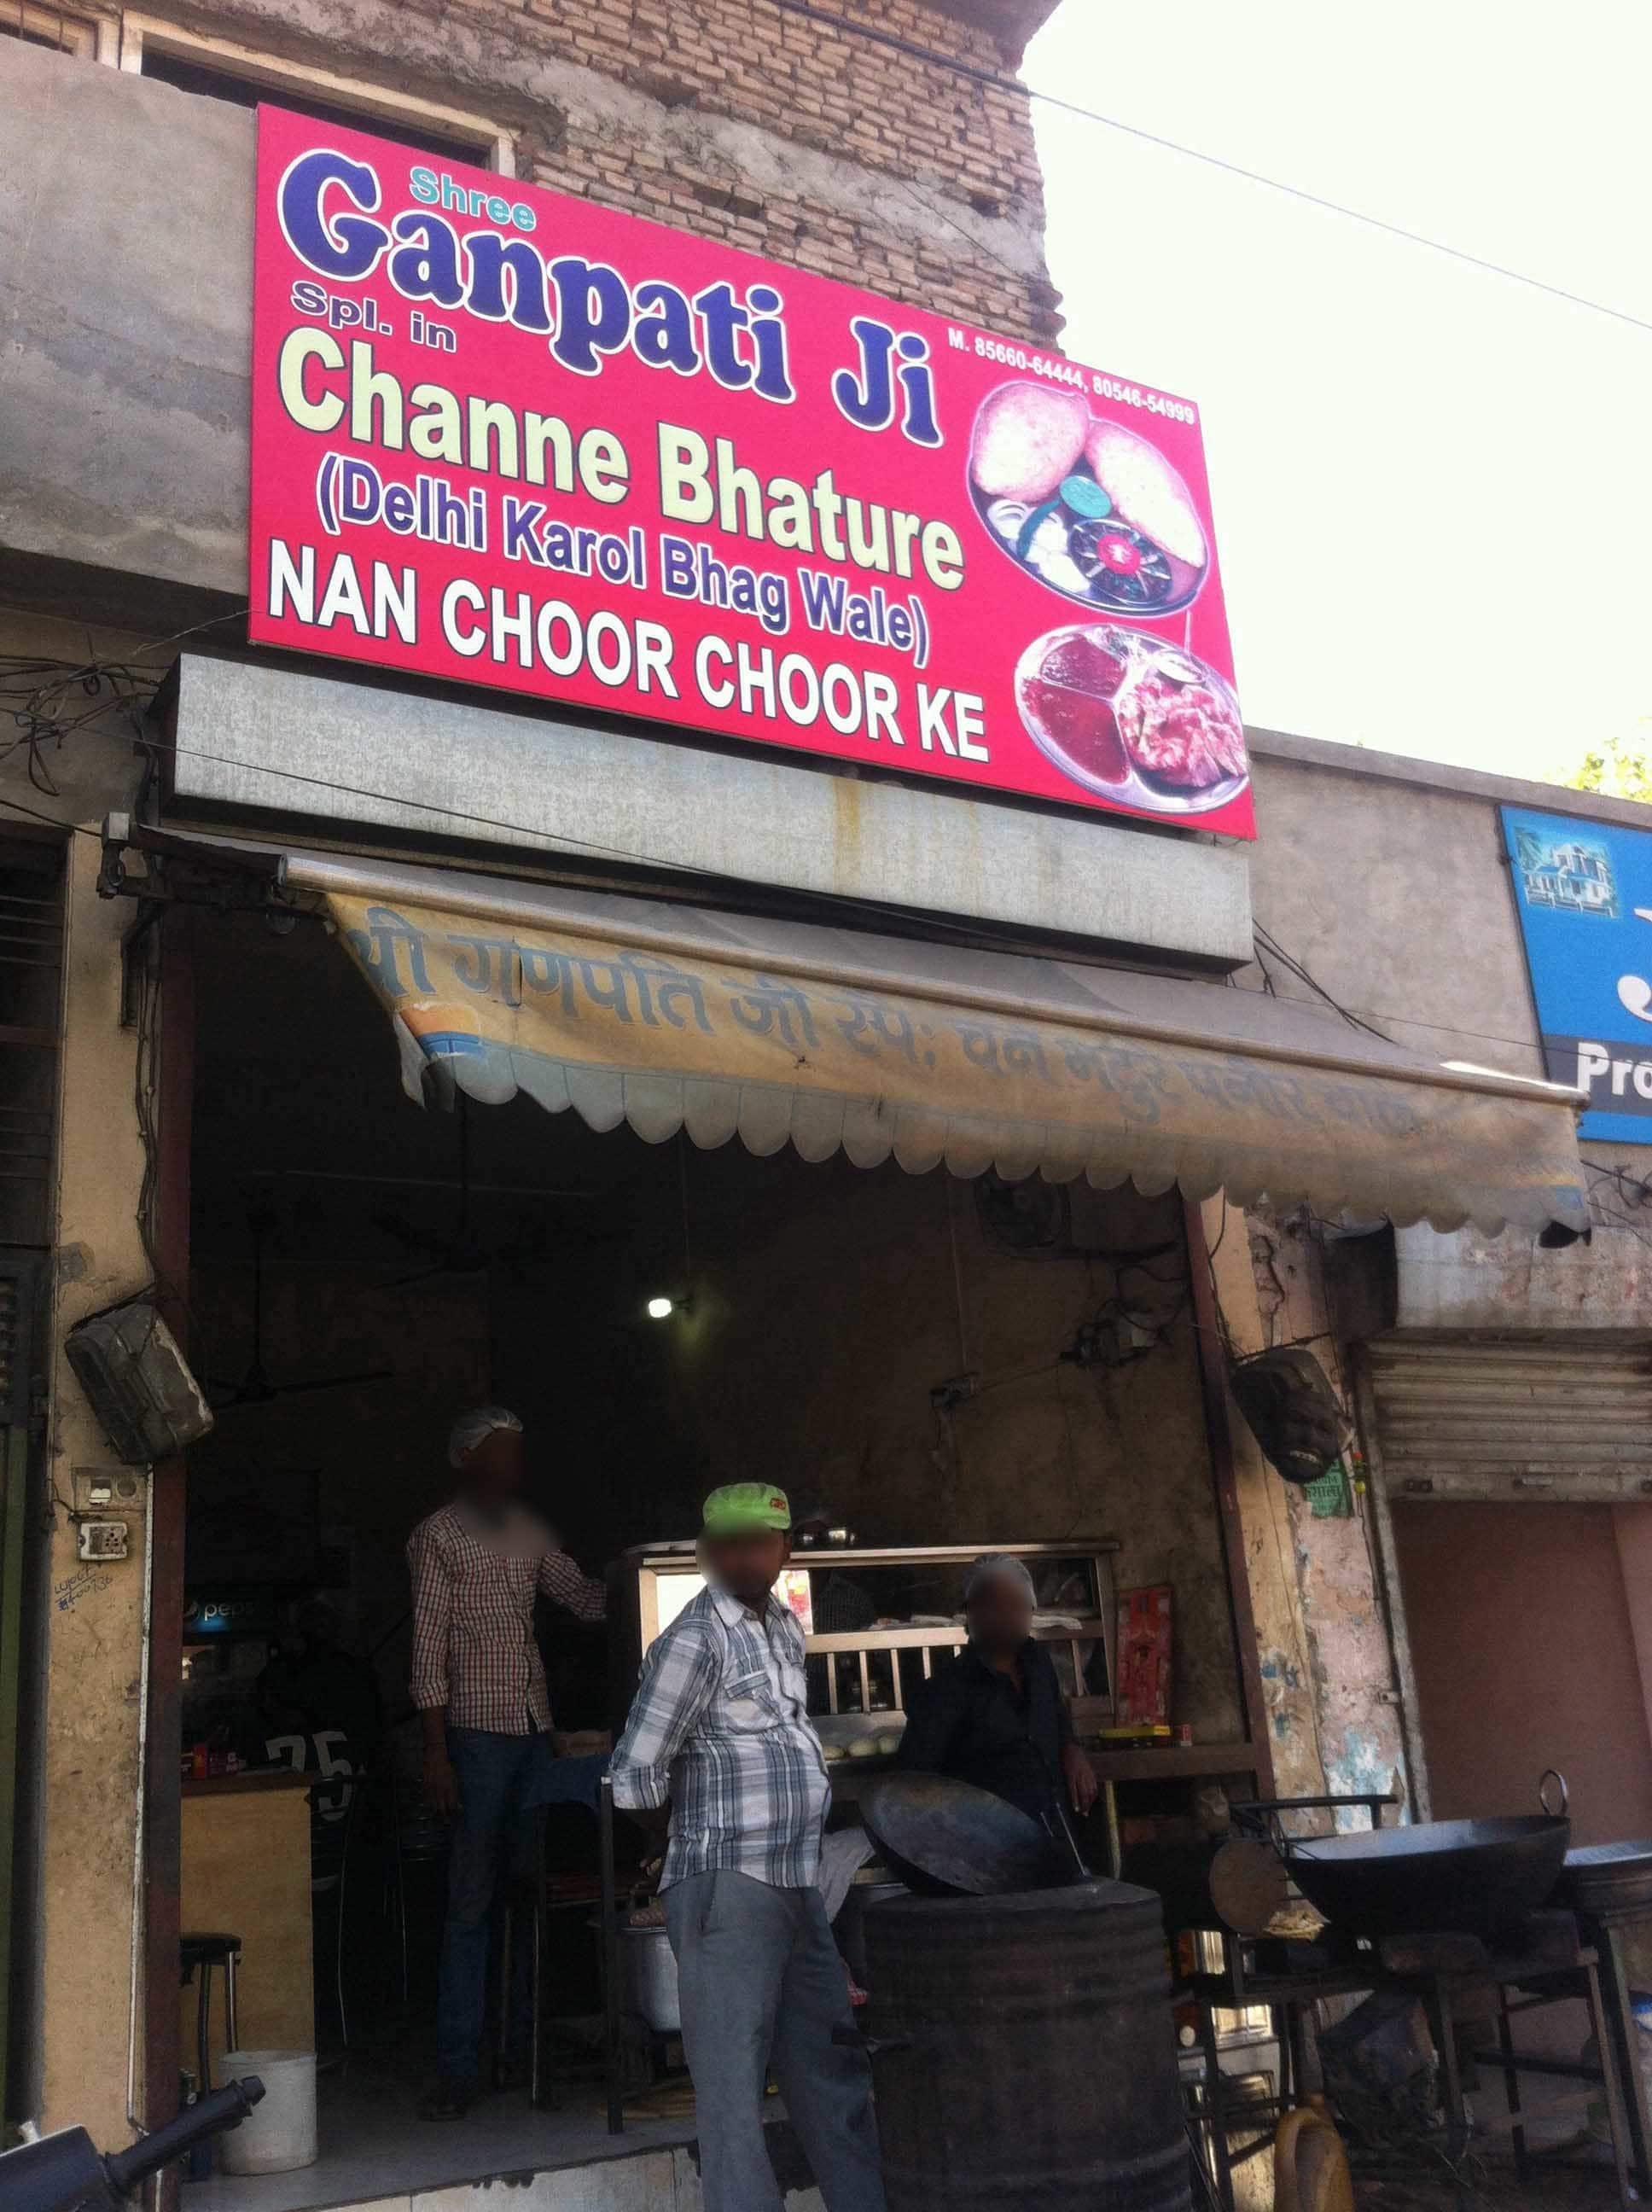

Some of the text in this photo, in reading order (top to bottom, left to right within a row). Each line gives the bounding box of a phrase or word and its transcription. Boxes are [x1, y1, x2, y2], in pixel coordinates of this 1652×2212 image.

[410, 167, 537, 231] Shree
[277, 148, 944, 448] Ganpati Ji
[290, 280, 457, 353] Spl. in
[948, 327, 1195, 425] M. 85660-64444, 80546-54999
[275, 325, 965, 591] Channe Bhature
[316, 451, 931, 669] (Delhi Karol Bhag Wale)
[268, 538, 990, 763] NAN CHOOR CHOOR KE
[449, 934, 715, 1033] गणपति
[724, 973, 824, 1051] जी
